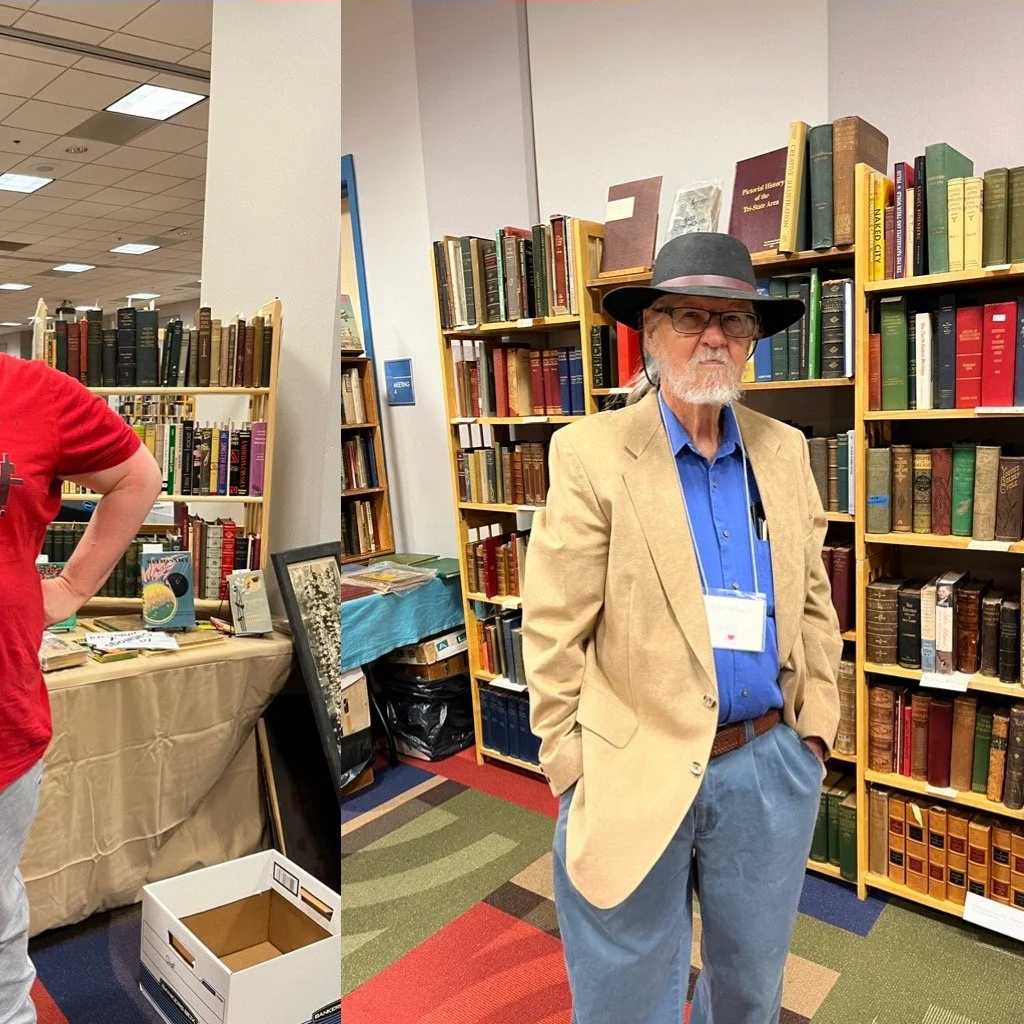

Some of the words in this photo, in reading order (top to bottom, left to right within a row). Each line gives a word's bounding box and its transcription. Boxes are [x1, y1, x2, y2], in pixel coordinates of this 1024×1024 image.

[787, 144, 796, 176] CREATIVE
[742, 184, 764, 196] Pictorial
[764, 180, 785, 191] History
[743, 202, 766, 213] Tri-State
[766, 199, 779, 208] Area
[783, 178, 793, 228] ILLUSTRATION
